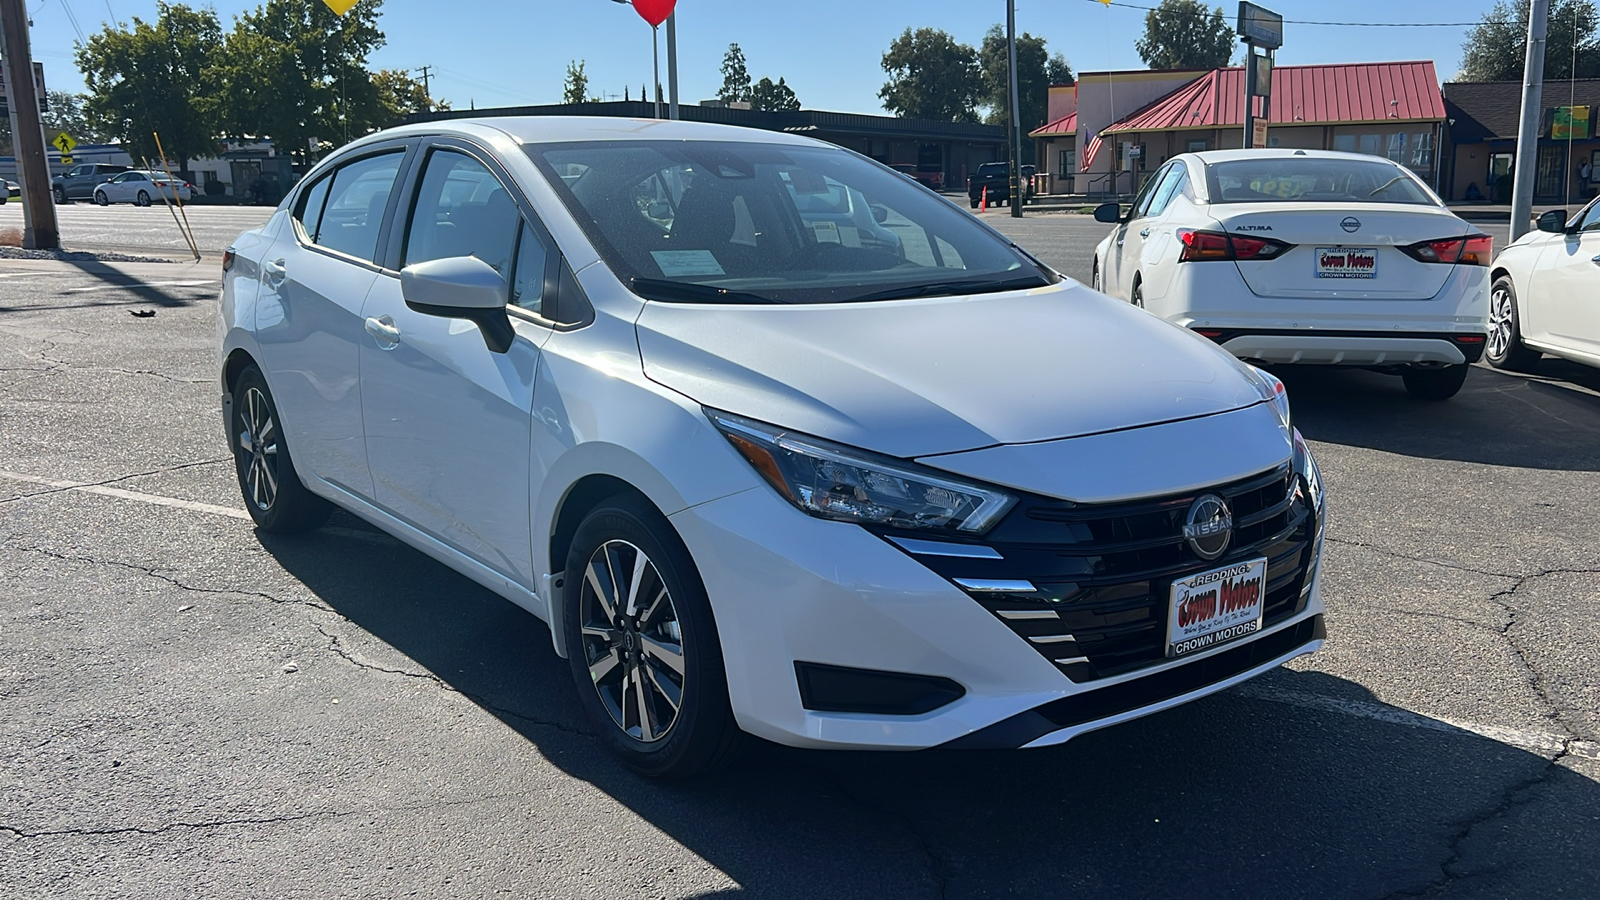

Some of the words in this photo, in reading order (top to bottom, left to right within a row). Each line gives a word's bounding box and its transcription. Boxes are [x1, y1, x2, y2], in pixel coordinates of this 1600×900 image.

[1320, 252, 1345, 267] Crown
[1346, 252, 1374, 268] Motors
[1185, 518, 1232, 537] NISSAN
[1196, 566, 1246, 584] REDDING
[1178, 589, 1217, 628] Crown
[1219, 576, 1261, 616] Motors
[1175, 633, 1213, 654] CROWN
[1215, 621, 1257, 642] MOTORS
